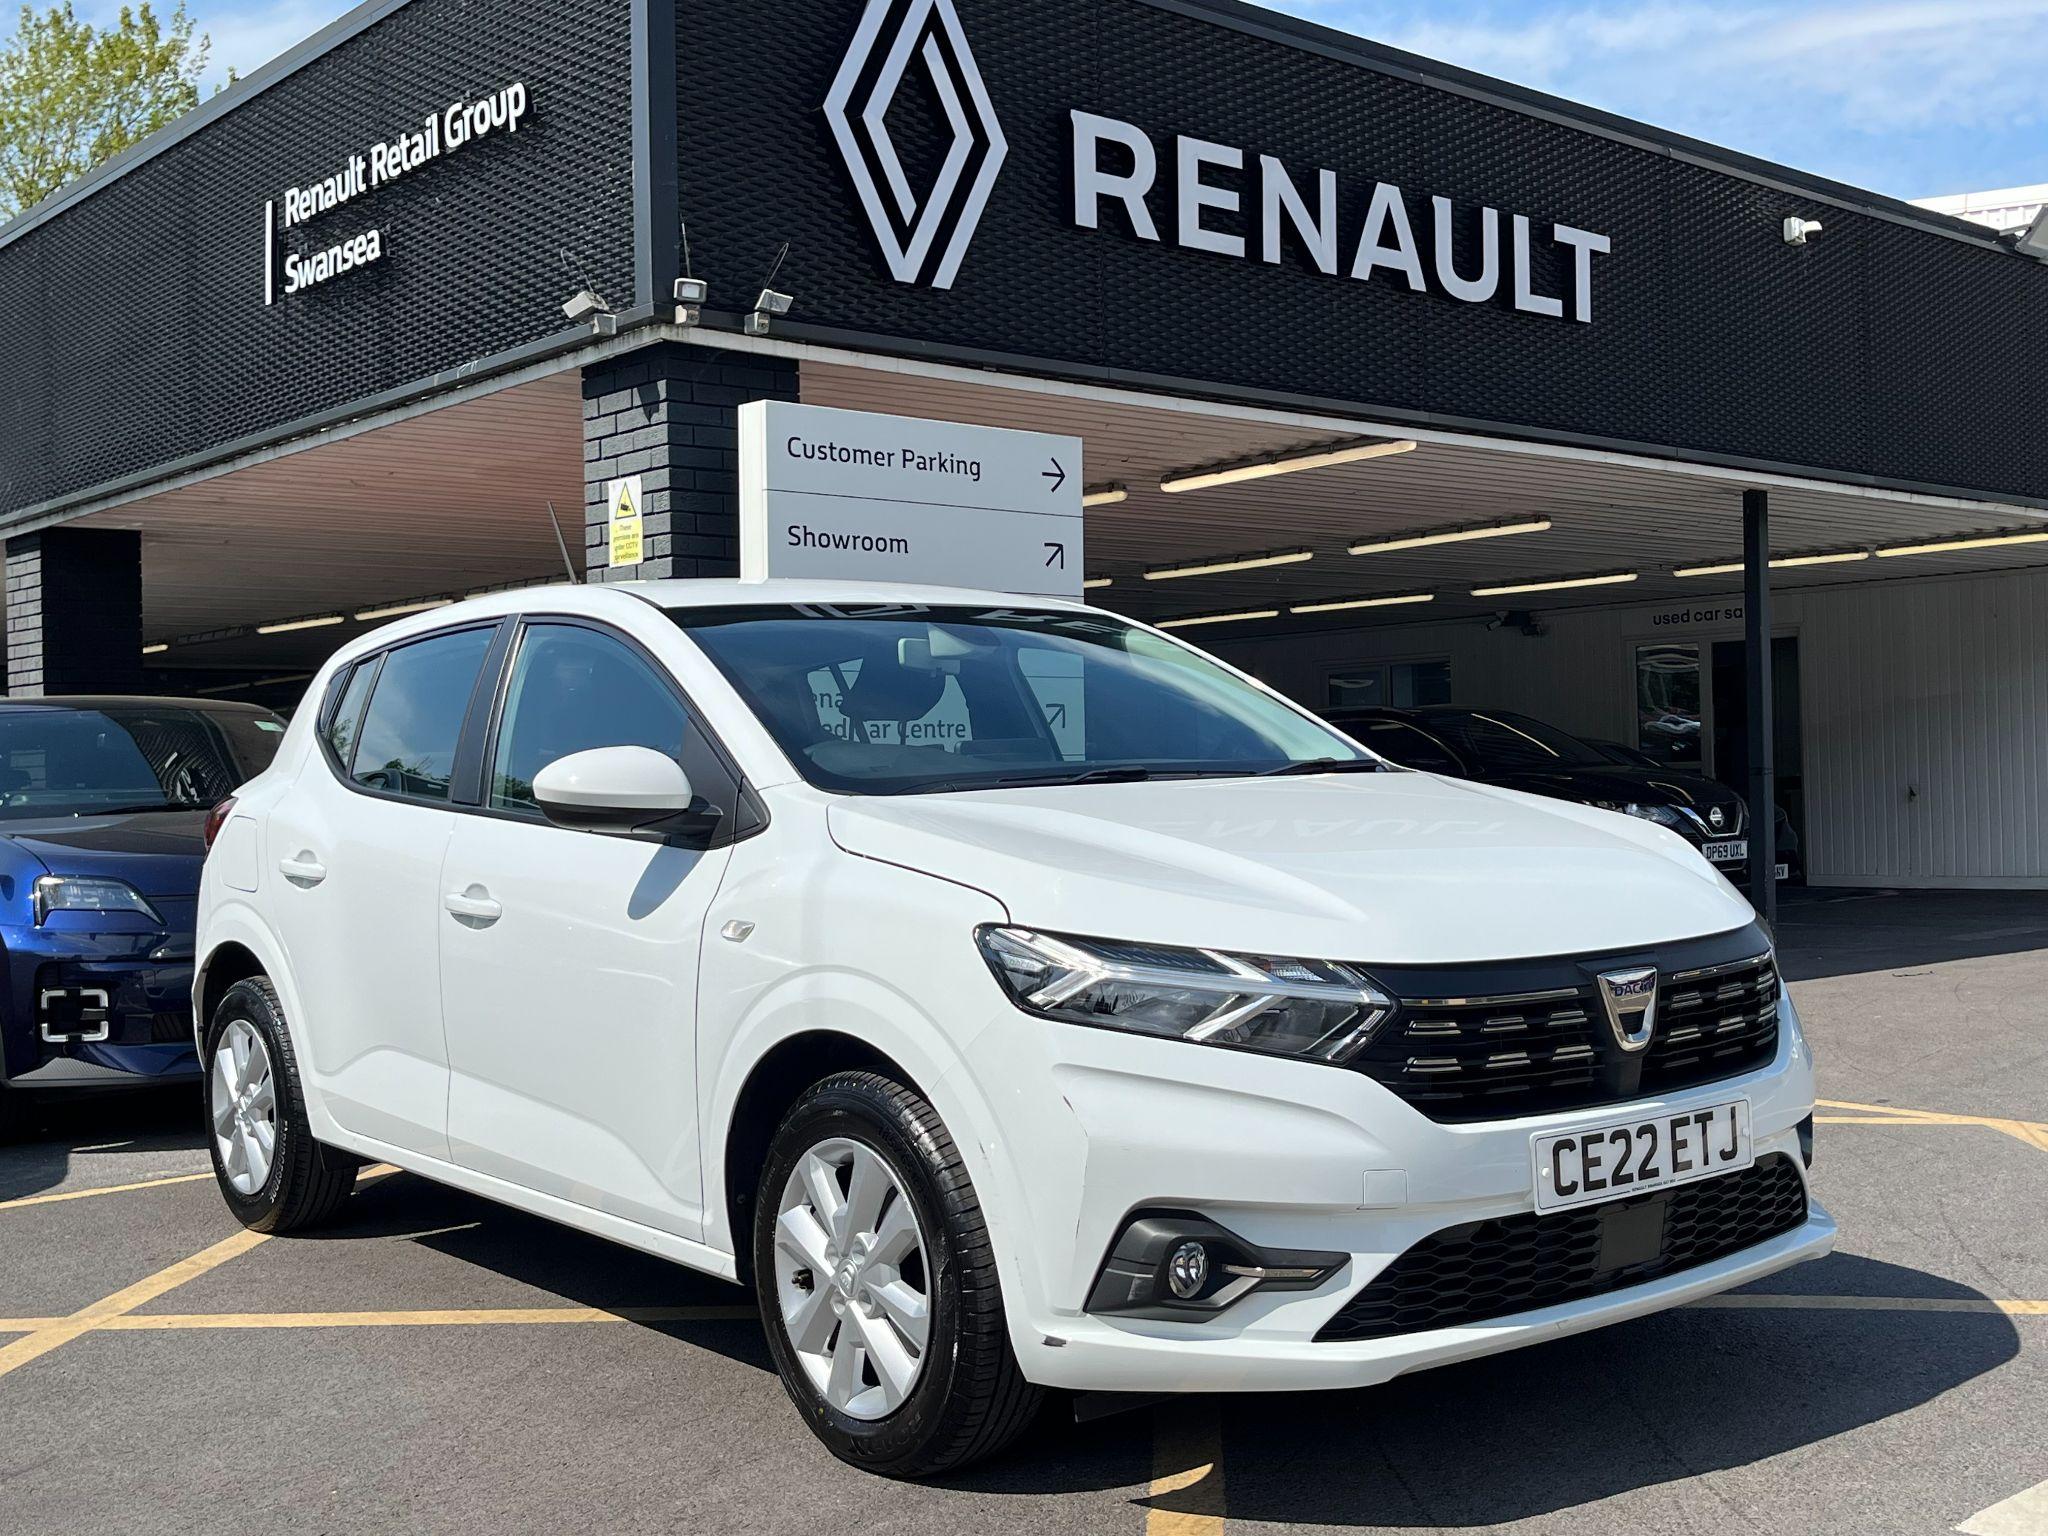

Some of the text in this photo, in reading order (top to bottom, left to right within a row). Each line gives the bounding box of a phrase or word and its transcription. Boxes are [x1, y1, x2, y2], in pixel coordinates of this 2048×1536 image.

[284, 82, 526, 228] Renault Retail Group
[1070, 109, 1611, 323] RENAULT
[284, 229, 381, 294] Swansea
[787, 436, 981, 482] Customer Parking
[787, 525, 909, 554] Showroom
[1653, 607, 1743, 626] used car sa
[820, 717, 848, 739] ed
[869, 721, 891, 739] ar
[1706, 843, 1745, 860] DP69 UXL
[1552, 1106, 1738, 1197] CE22 ETJ
